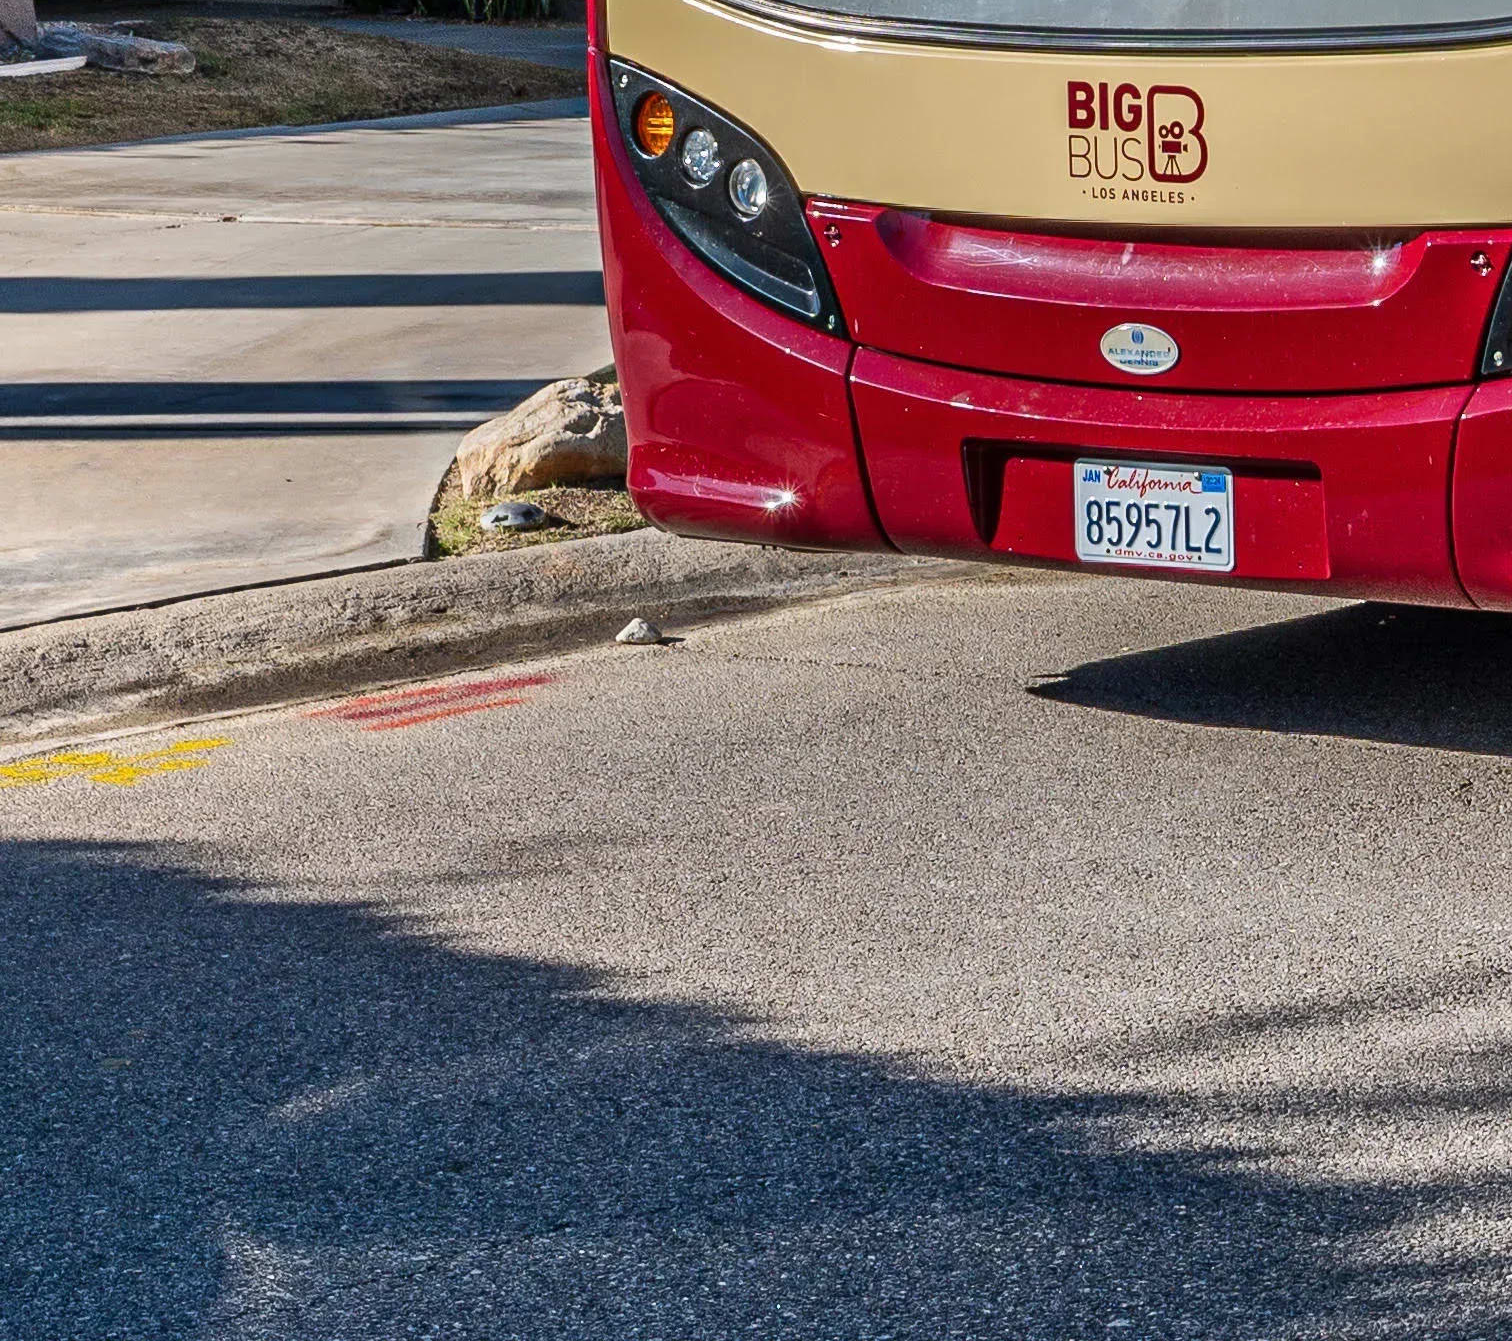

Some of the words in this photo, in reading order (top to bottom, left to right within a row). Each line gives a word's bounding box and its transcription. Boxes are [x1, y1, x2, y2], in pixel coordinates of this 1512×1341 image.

[1067, 81, 1143, 132] BIG
[1068, 135, 1145, 181] BUS
[1092, 187, 1116, 200] LOS
[1122, 189, 1185, 204] ANGELES
[1082, 468, 1101, 484] JAN
[1106, 466, 1203, 499] California
[1086, 499, 1223, 555] 85957L2
[1114, 547, 1194, 561] dmv.ca.gov
